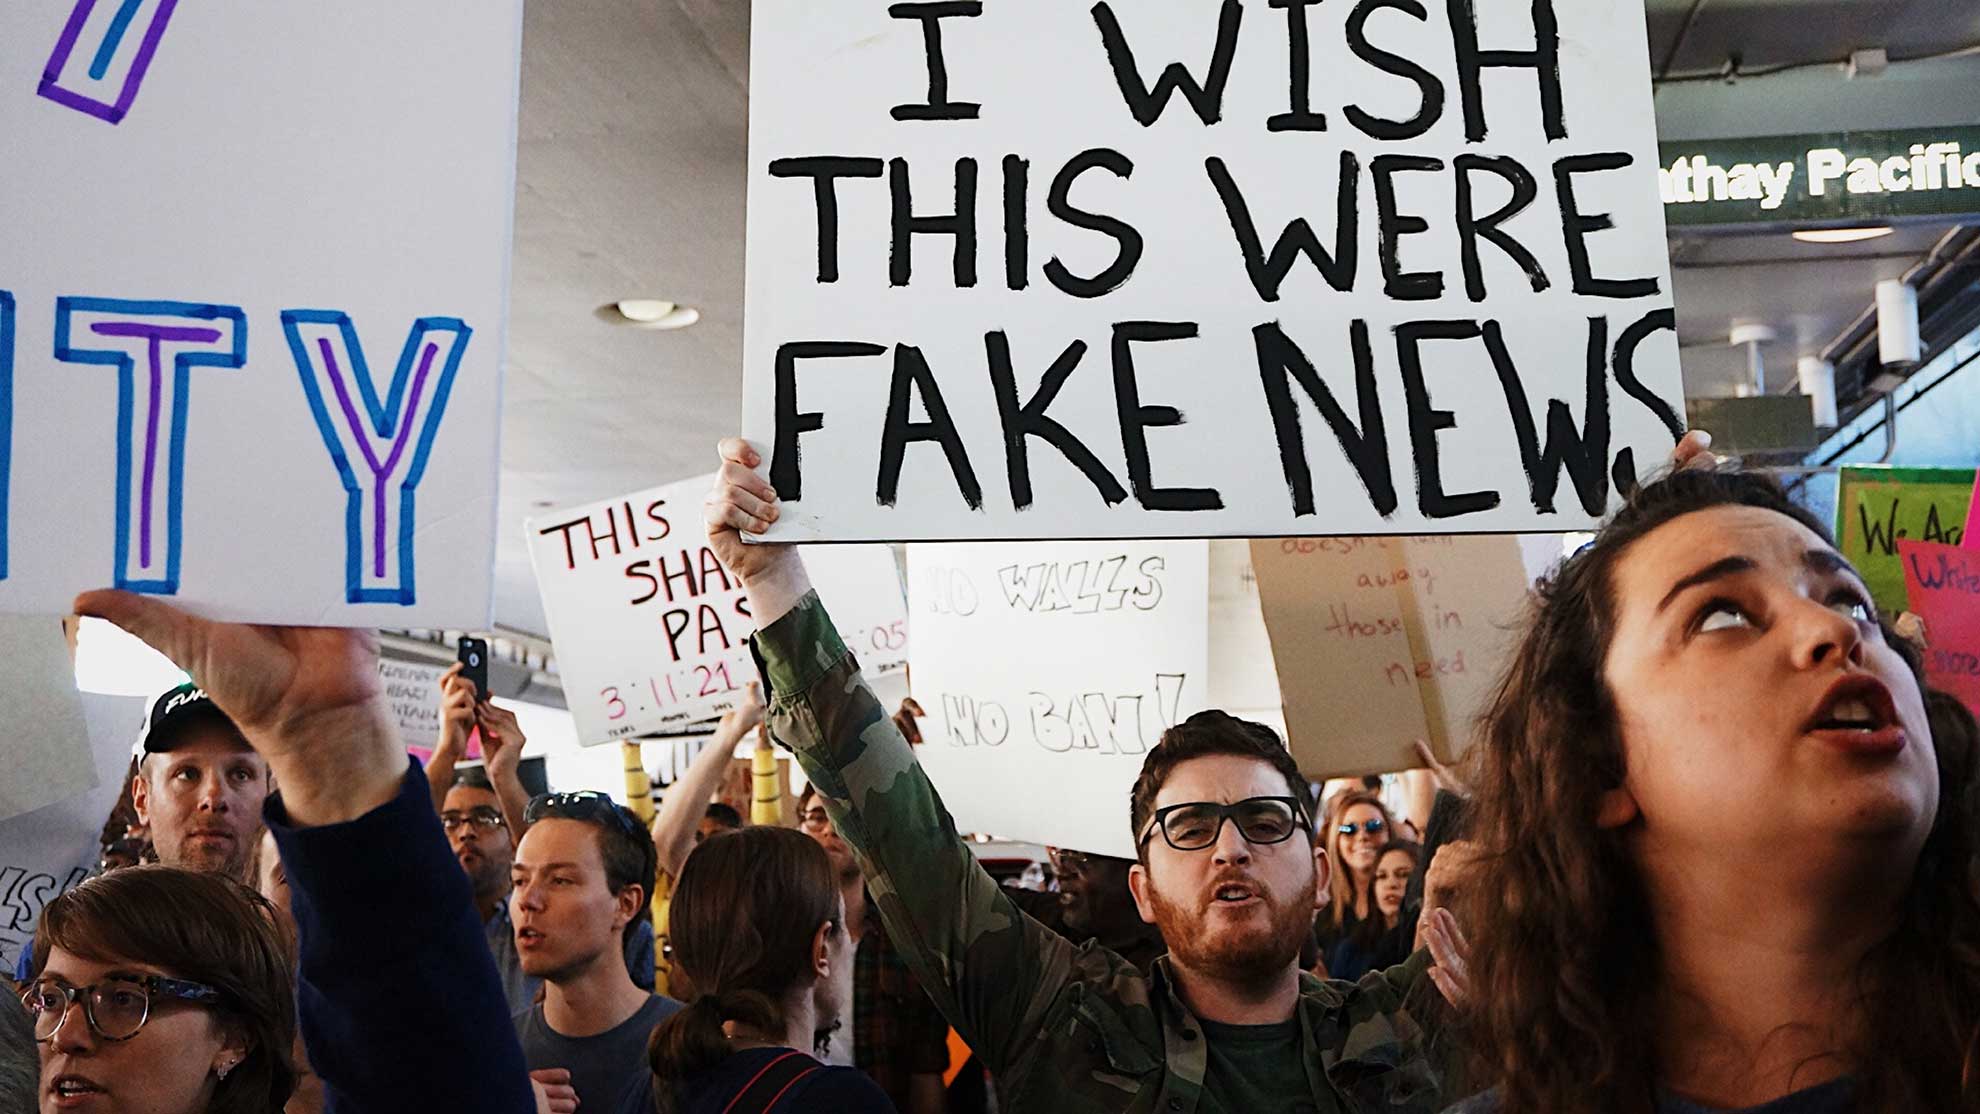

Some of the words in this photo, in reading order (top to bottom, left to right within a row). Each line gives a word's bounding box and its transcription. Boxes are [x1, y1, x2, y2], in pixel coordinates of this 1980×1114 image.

[888, 0, 983, 121] I
[1090, 0, 1568, 143] WISH
[768, 147, 1144, 298] THIS
[1205, 150, 1661, 302] WERE
[769, 319, 1225, 513] FAKE
[1252, 306, 1687, 521] NEWS
[540, 499, 671, 570] THIS
[625, 545, 744, 605] SHA
[997, 555, 1165, 614] WALLS
[1325, 602, 1402, 639] those
[1434, 602, 1463, 630] in
[1385, 650, 1466, 687] need
[941, 692, 1010, 747] NO
